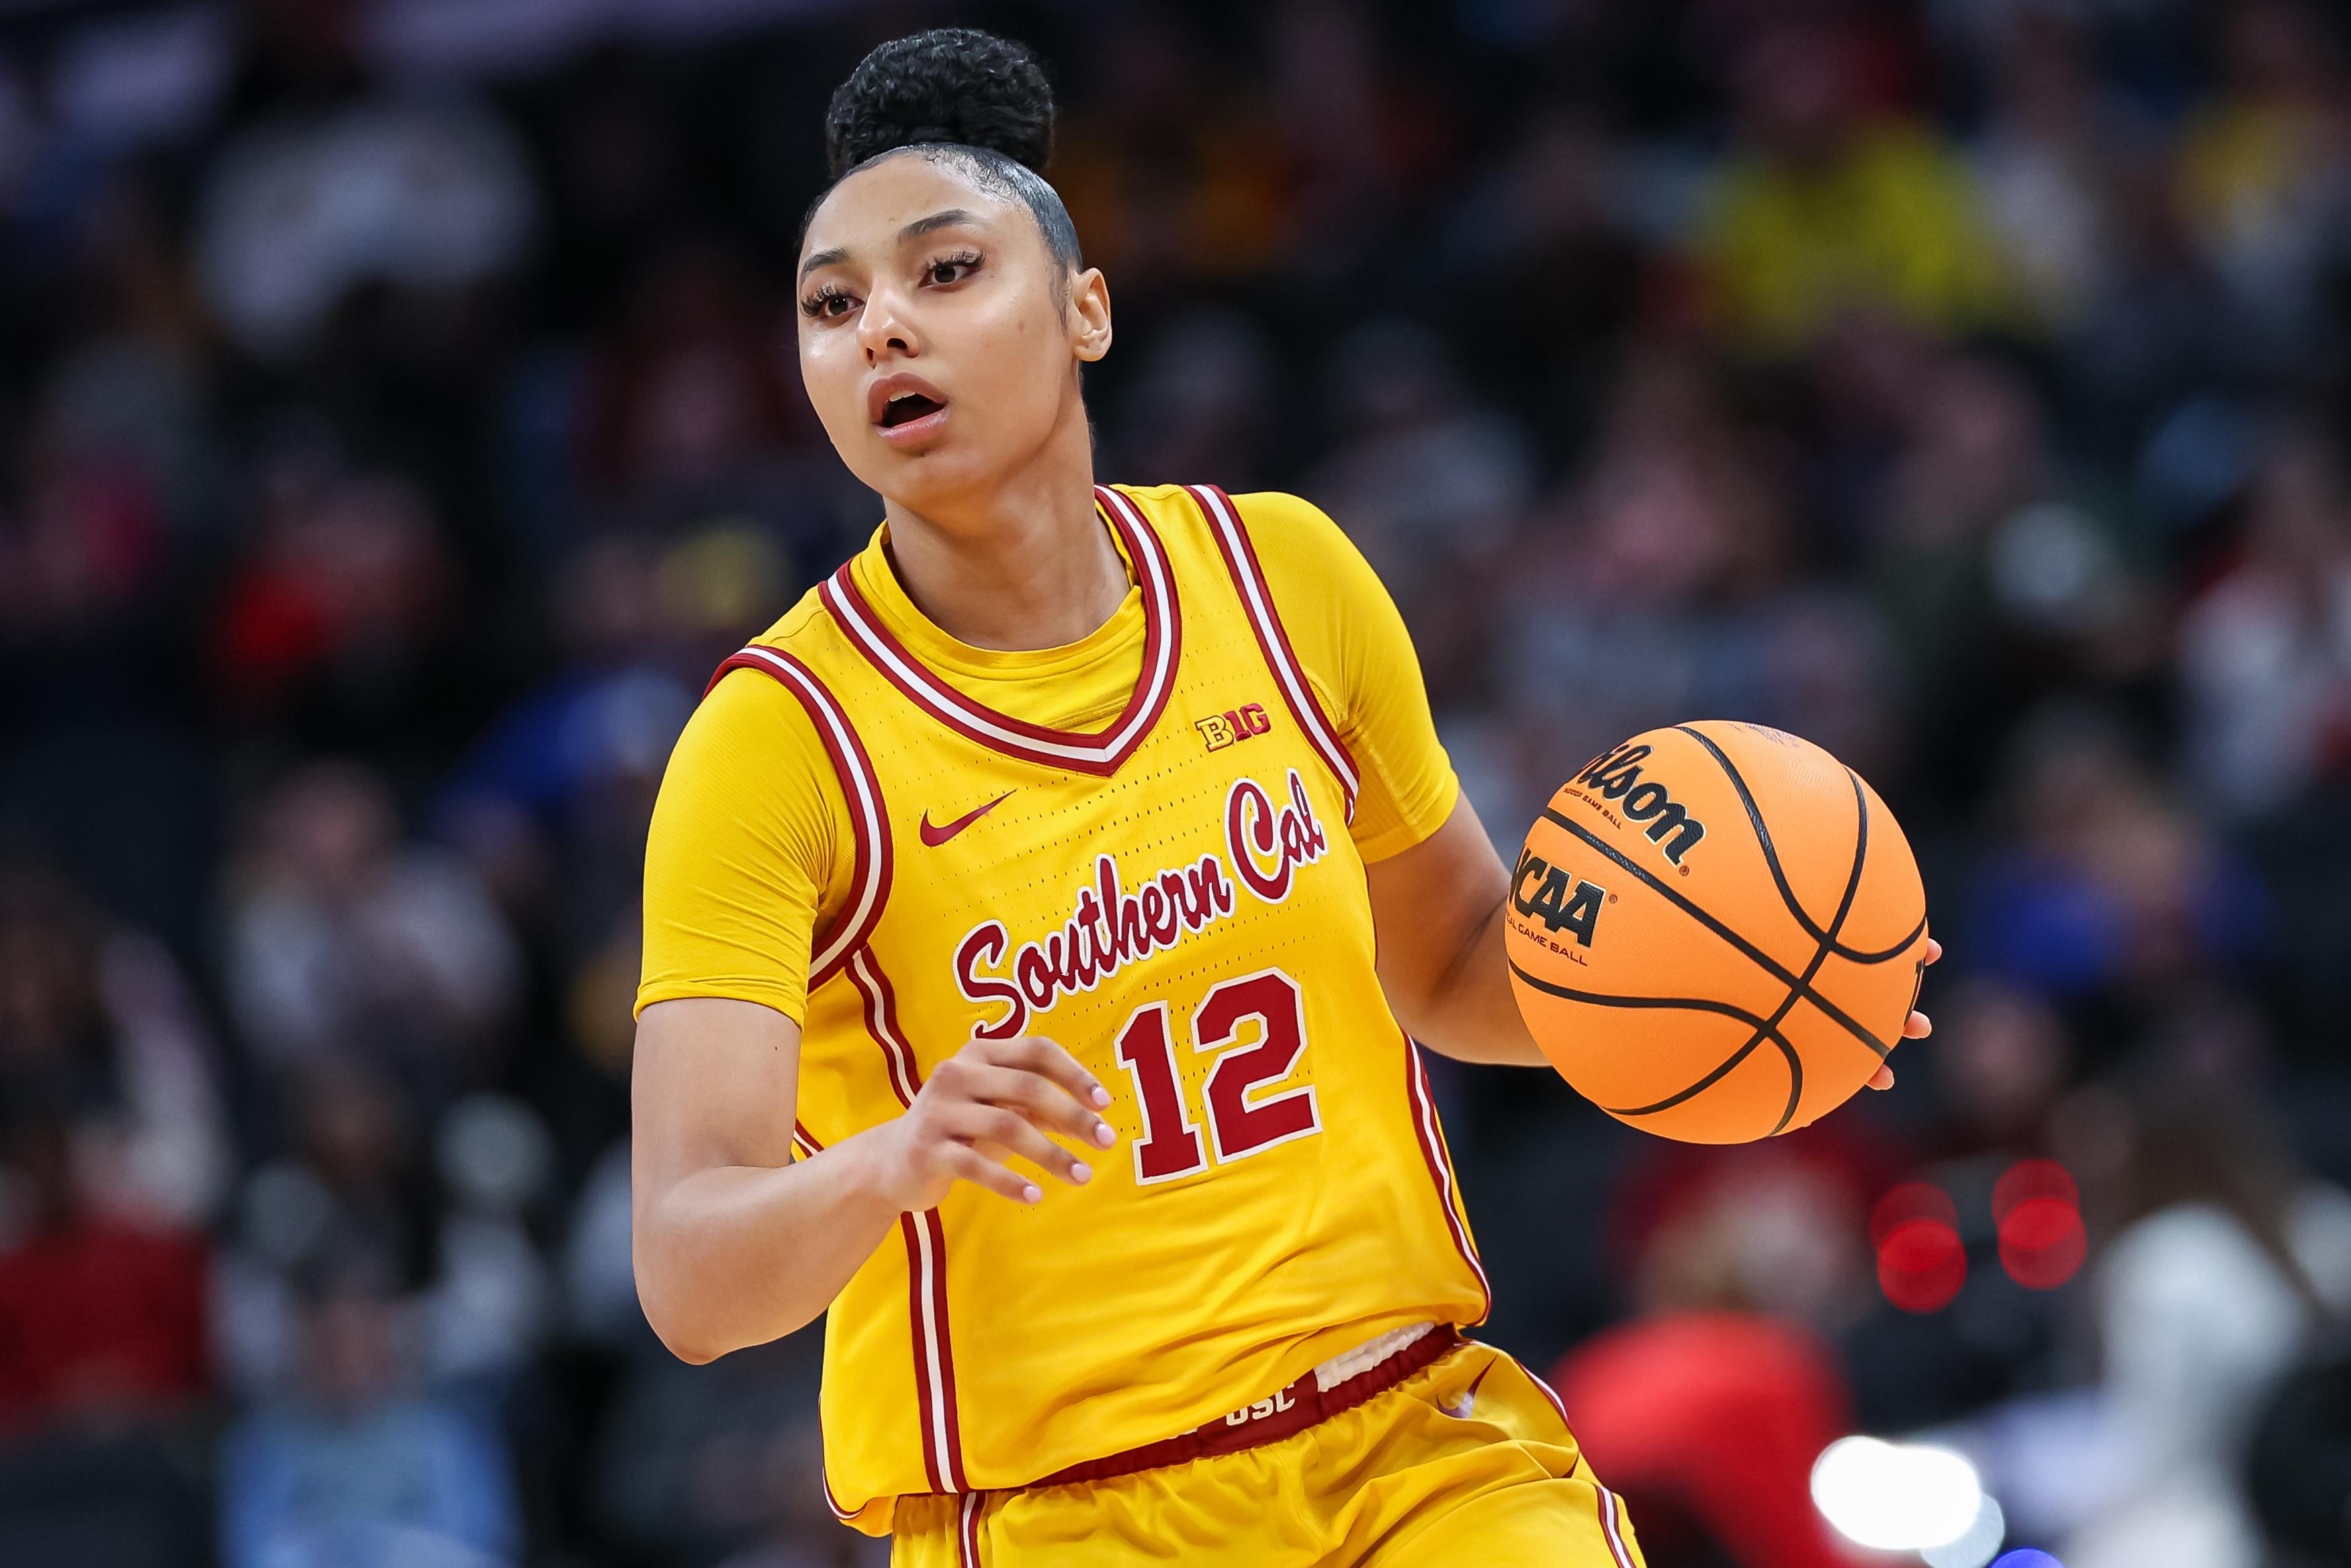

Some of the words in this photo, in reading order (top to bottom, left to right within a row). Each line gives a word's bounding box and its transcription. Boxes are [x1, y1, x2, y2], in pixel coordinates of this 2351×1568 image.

[1577, 744, 1706, 868] ilson
[1602, 809, 1621, 830] BALL
[952, 854, 1236, 1040] Southern
[1224, 767, 1329, 904] Cal
[1518, 923, 1548, 948] GAME
[1550, 942, 1588, 967] BALL
[1113, 966, 1323, 1186] 12
